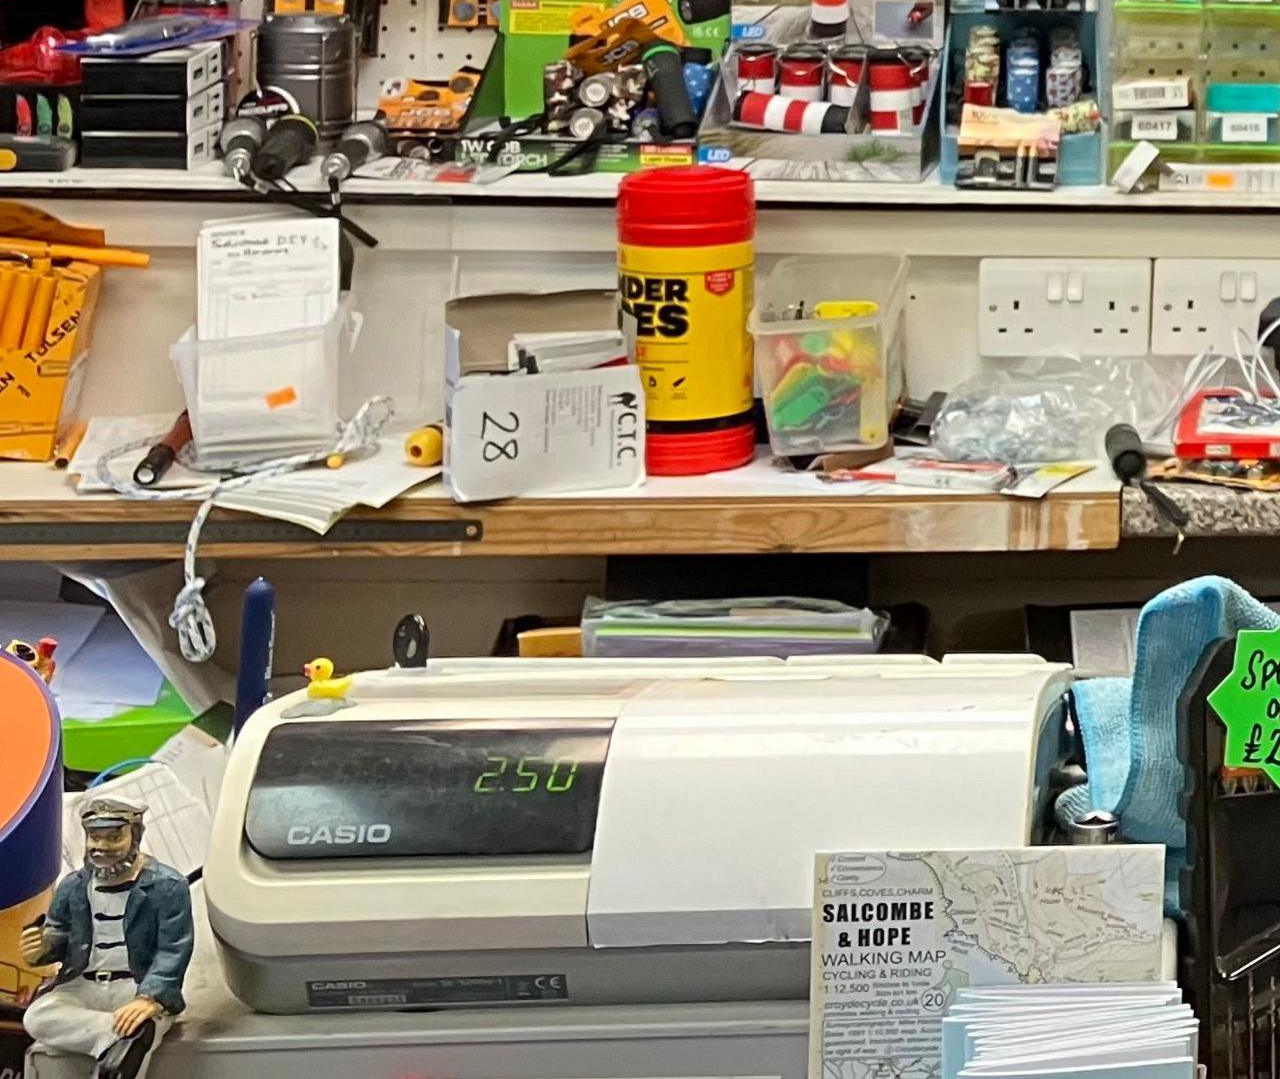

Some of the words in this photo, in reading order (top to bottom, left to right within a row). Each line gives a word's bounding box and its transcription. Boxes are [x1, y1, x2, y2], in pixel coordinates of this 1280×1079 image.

[742, 25, 764, 37] LED
[707, 149, 730, 161] LED
[482, 411, 520, 464] 28
[287, 822, 392, 846] CASIO
[822, 901, 935, 923] SALCOMBE
[838, 931, 852, 947] &
[858, 927, 911, 946] HOPE
[822, 951, 903, 966] WALKING
[908, 950, 947, 964] MAP
[822, 968, 877, 980] CYCLING
[879, 968, 888, 979] &
[890, 967, 933, 980] RIDING
[311, 979, 368, 991] CASIO
[824, 996, 920, 1011] croydecycle.co.uk
[924, 994, 945, 1008] 20
